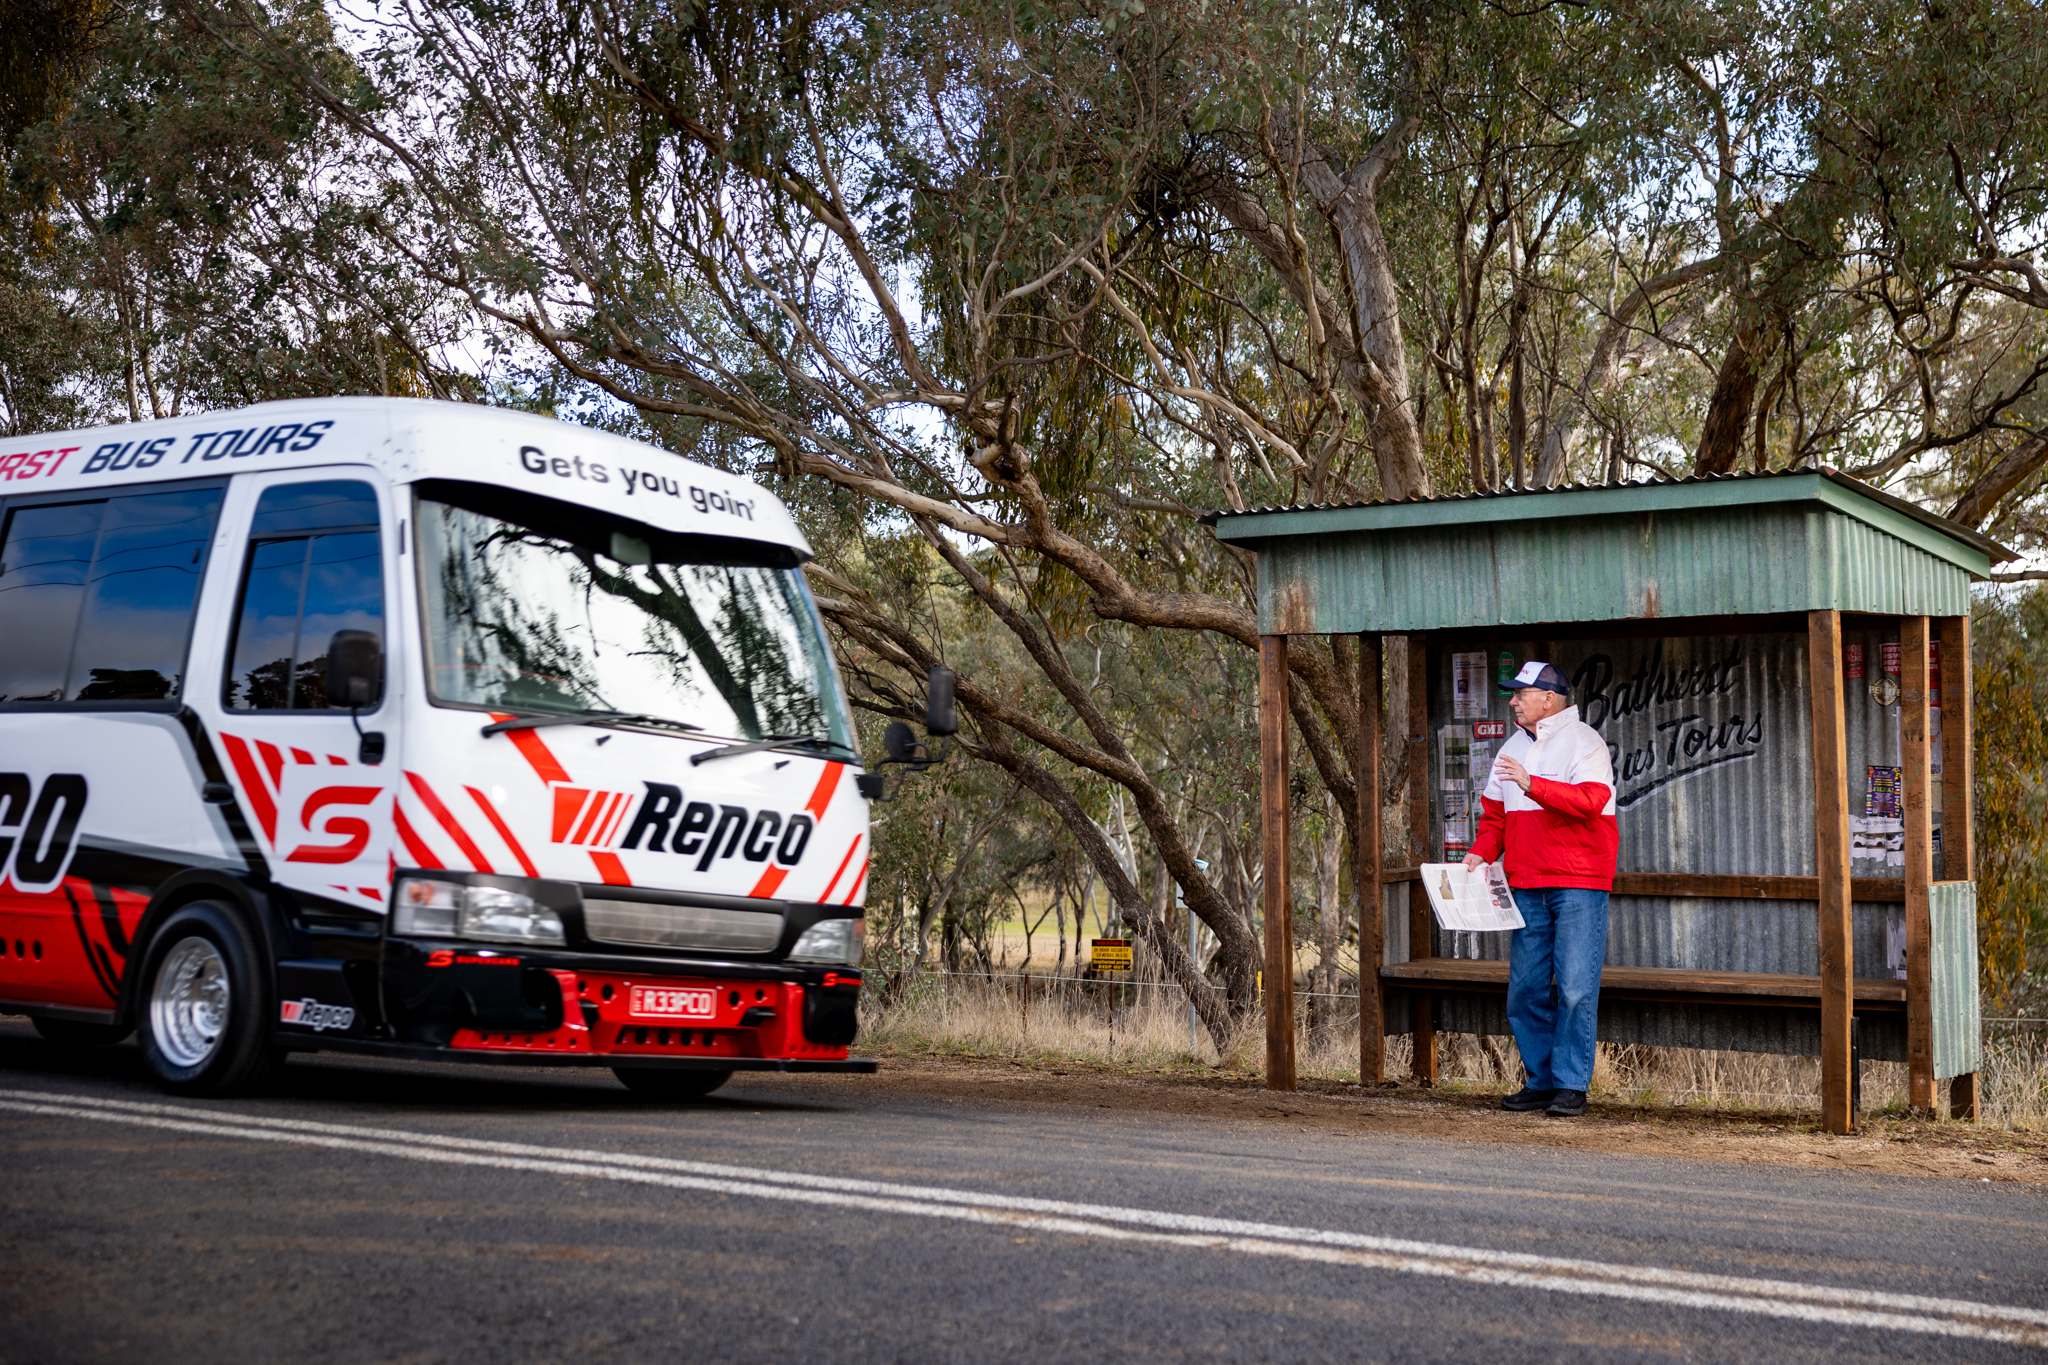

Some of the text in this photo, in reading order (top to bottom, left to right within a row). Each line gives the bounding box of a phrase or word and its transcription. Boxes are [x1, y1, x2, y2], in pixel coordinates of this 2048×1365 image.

[0, 420, 335, 482] RST BUS TOURS
[519, 446, 756, 521] Gets you goin'
[1571, 638, 1742, 731] Bathurst
[1477, 724, 1504, 735] GME
[1656, 712, 1764, 768] Tours
[620, 780, 814, 872] Repco
[299, 997, 356, 1031] Repco
[643, 990, 712, 1014] R33PCO
